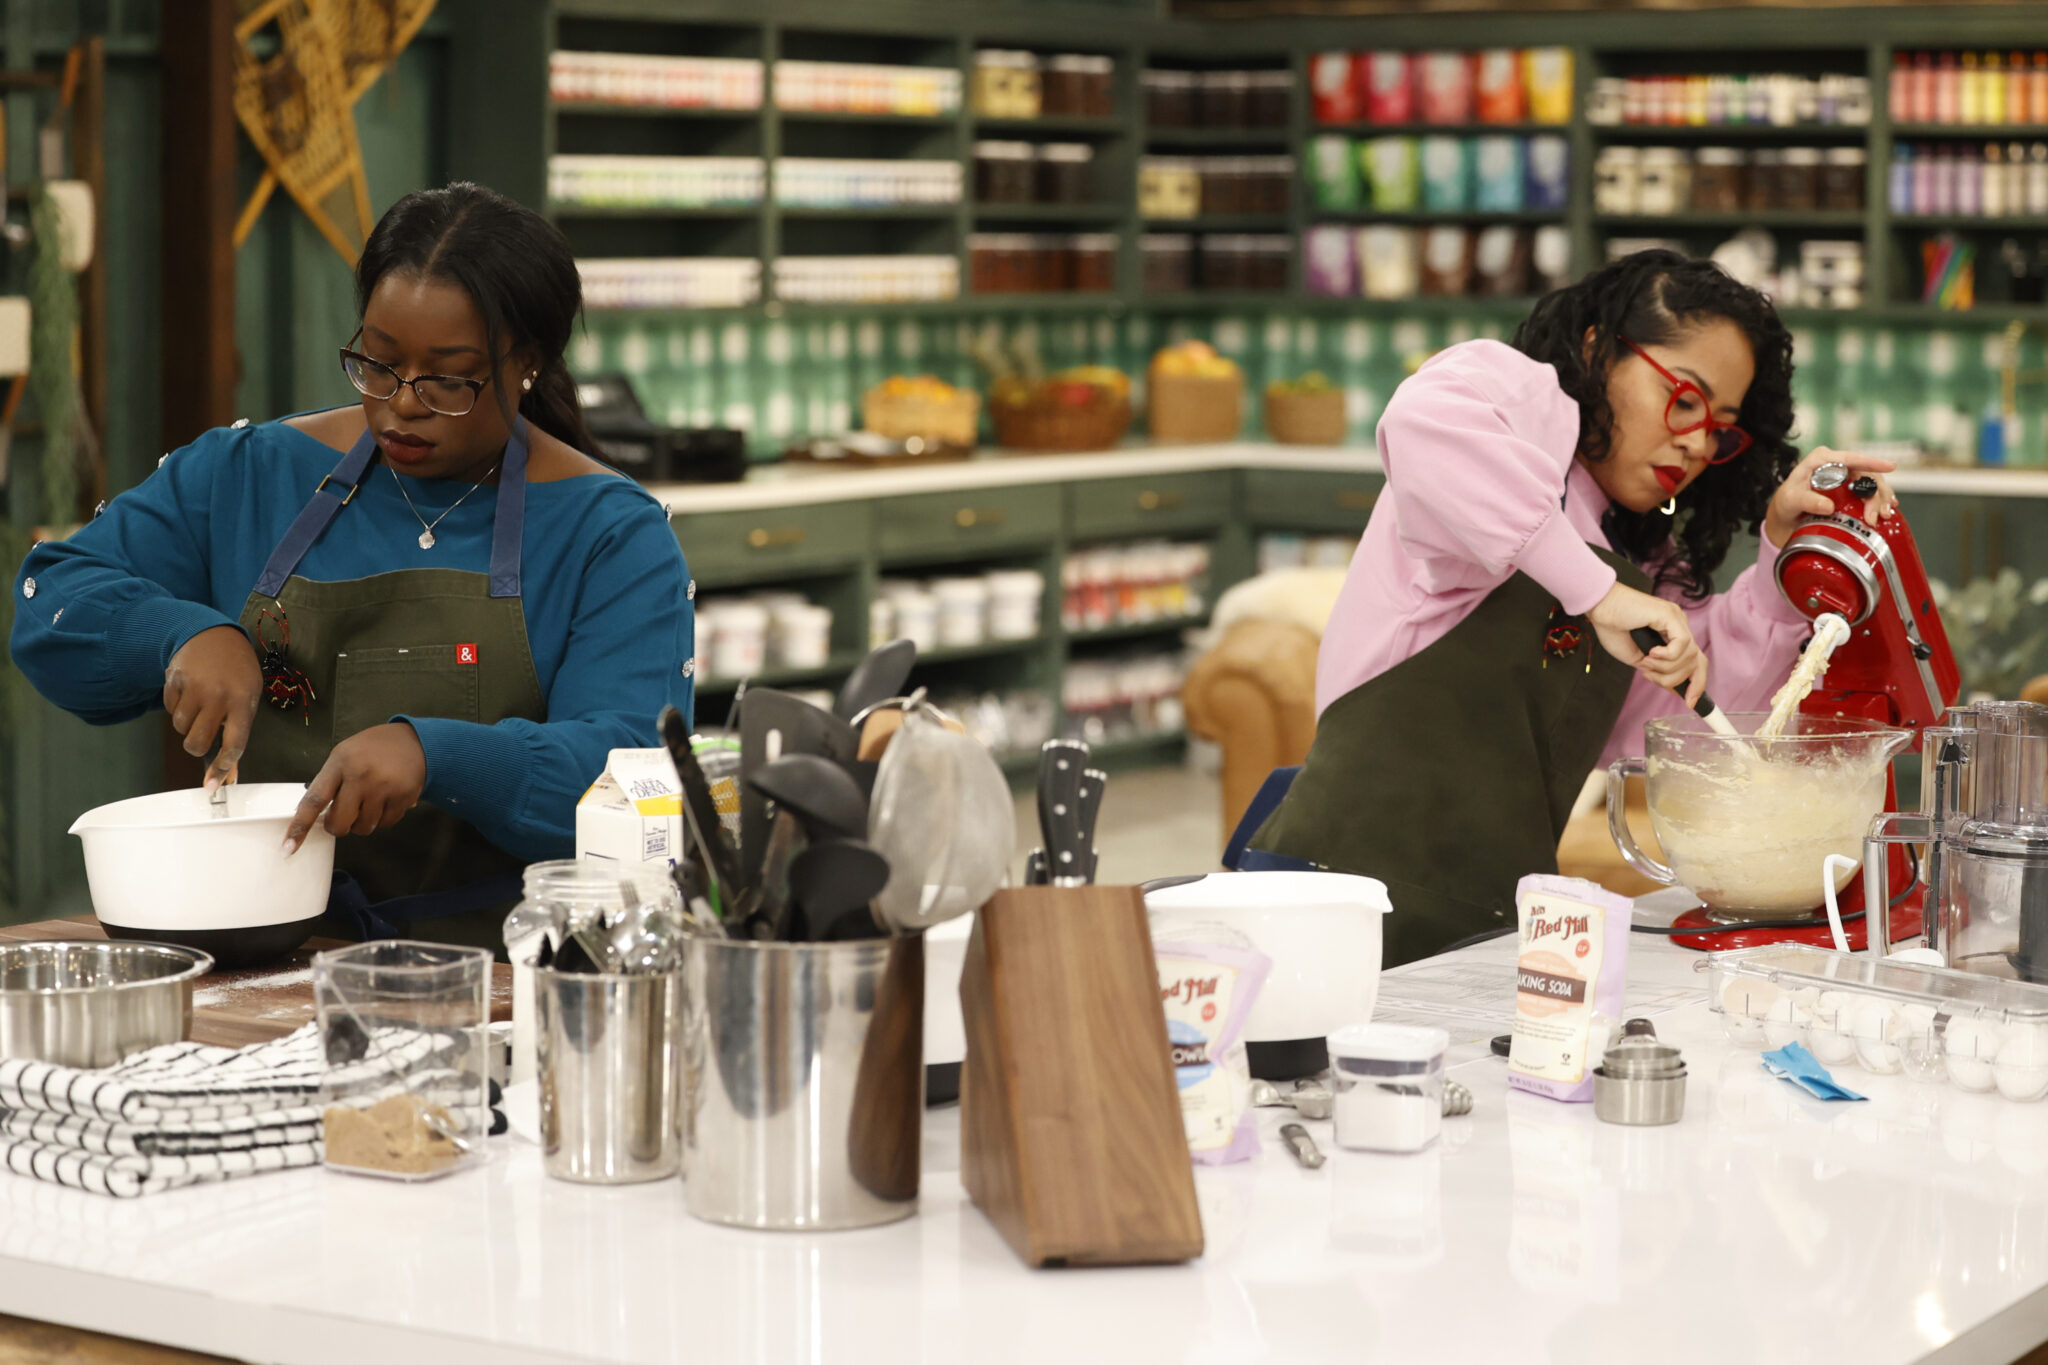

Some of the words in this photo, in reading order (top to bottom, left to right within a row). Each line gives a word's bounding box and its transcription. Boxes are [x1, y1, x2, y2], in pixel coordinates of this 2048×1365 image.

[461, 647, 472, 661] &
[630, 784, 673, 798] DENA
[1532, 915, 1562, 942] Red
[1561, 915, 1588, 941] Mill
[1161, 979, 1181, 1000] ed
[1182, 977, 1218, 1005] Mill
[1517, 973, 1546, 992] AKING
[1547, 979, 1572, 997] SODA
